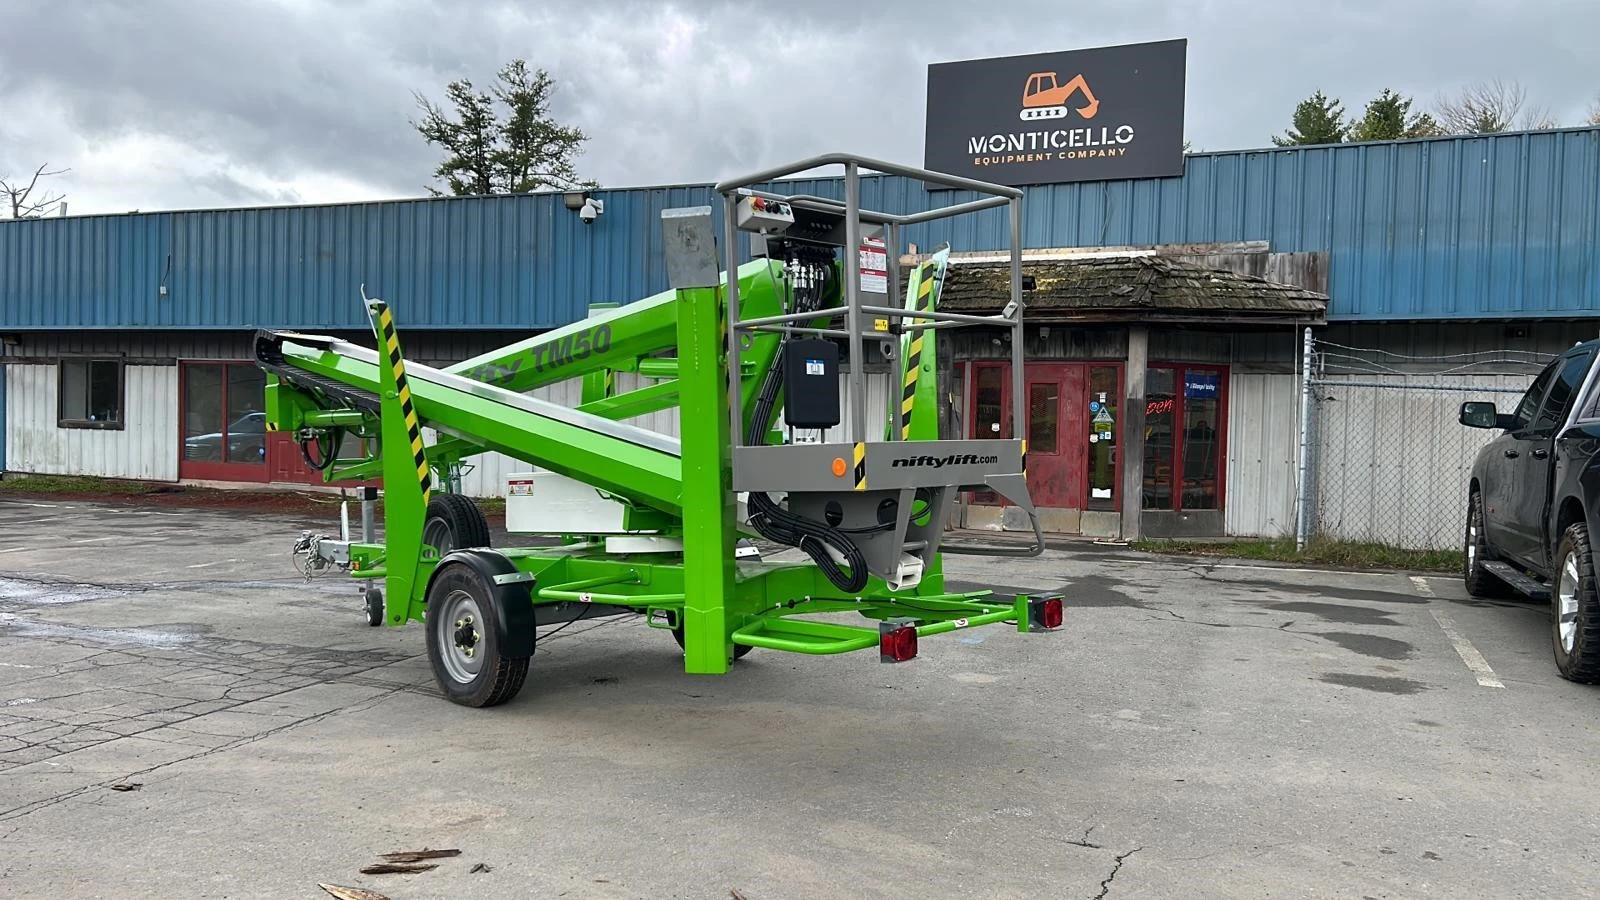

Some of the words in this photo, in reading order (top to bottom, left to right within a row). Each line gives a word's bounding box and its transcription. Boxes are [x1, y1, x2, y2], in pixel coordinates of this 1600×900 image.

[968, 125, 1134, 154] MONTICELLO
[974, 152, 1053, 166] EQUIPMENT
[1058, 147, 1126, 160] COMPANY
[531, 323, 612, 373] TM50
[892, 454, 998, 469] niftylift.com
